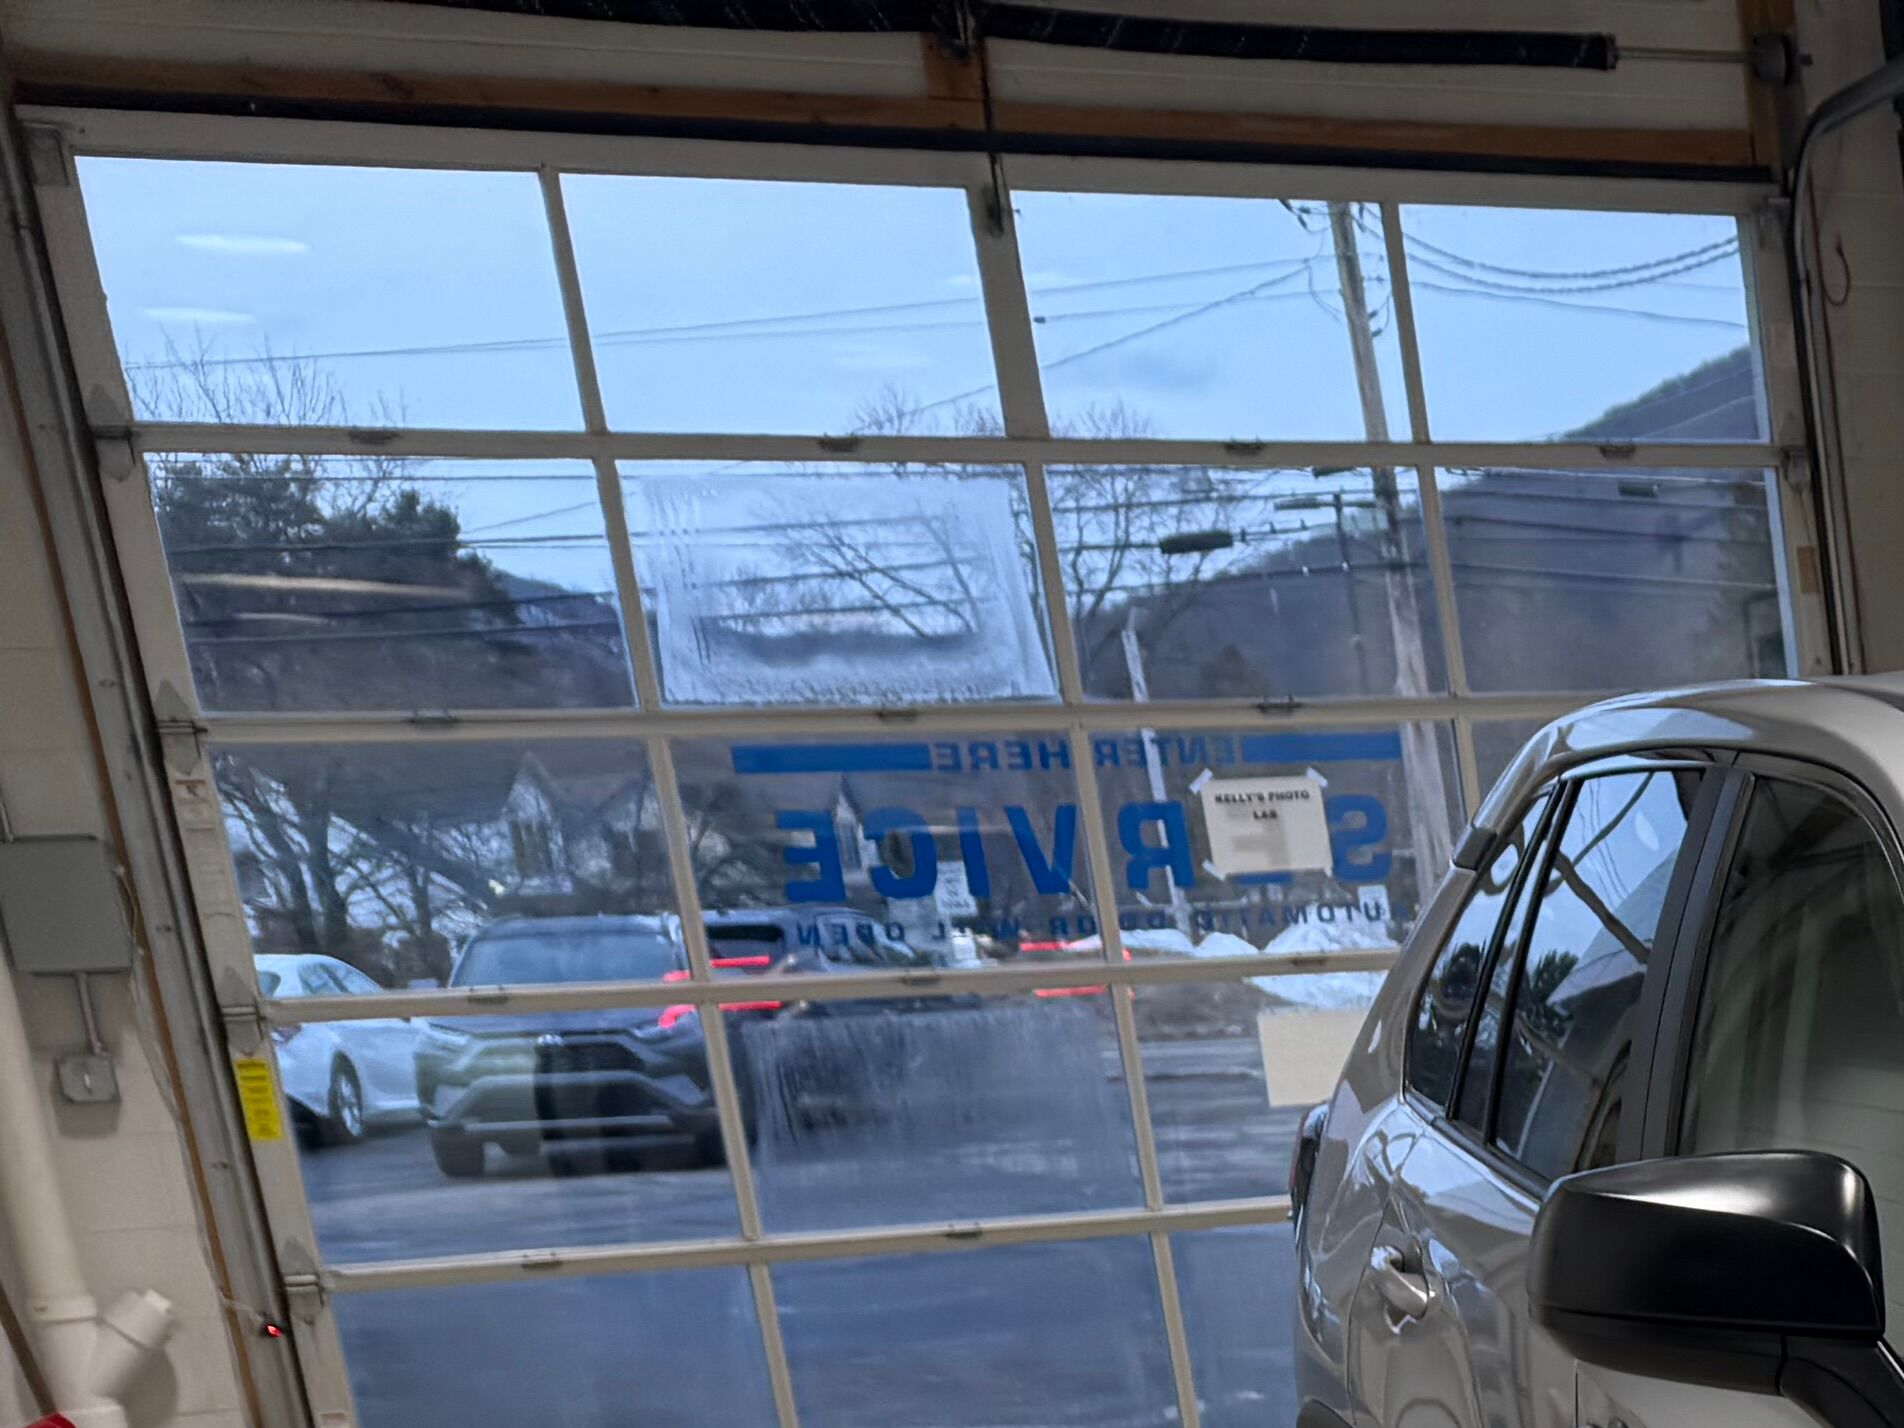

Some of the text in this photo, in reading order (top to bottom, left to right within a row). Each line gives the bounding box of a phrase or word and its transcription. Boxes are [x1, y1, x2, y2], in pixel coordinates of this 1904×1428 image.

[1214, 788, 1310, 803] KELLY'S PHOTO
[1253, 809, 1278, 820] LAB
